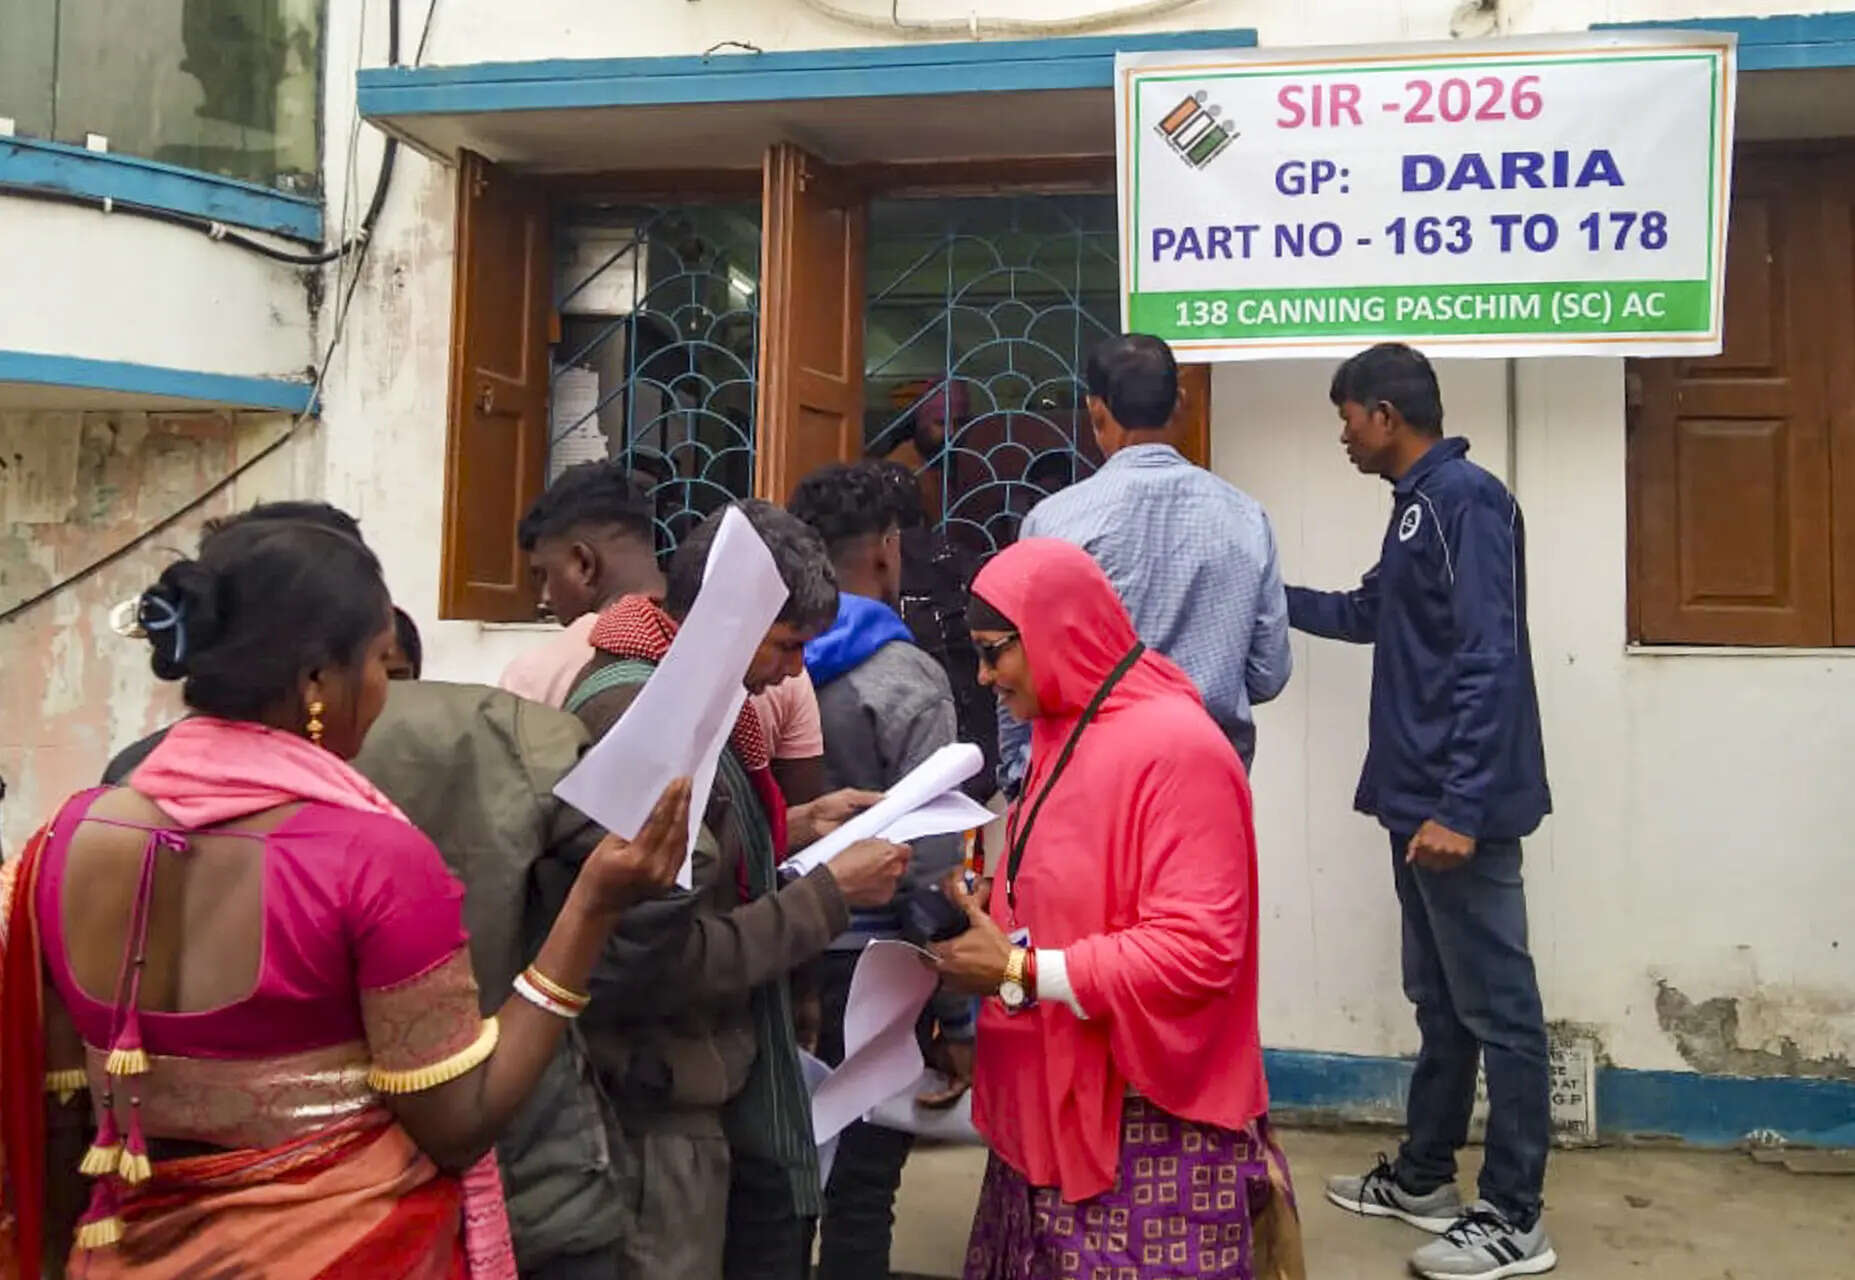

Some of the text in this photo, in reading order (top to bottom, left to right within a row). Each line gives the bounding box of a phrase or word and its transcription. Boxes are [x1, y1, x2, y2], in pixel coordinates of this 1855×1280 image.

[1276, 84, 1362, 128] SIR
[1275, 149, 1625, 196] GP: DARIA
[1152, 225, 1260, 262] PART
[1274, 222, 1342, 258] NO
[1385, 216, 1473, 255] 163
[1491, 214, 1559, 253] TO
[1580, 211, 1667, 251] 178
[1176, 291, 1665, 326] 138 CANNING PASCHIM (SC) AC
